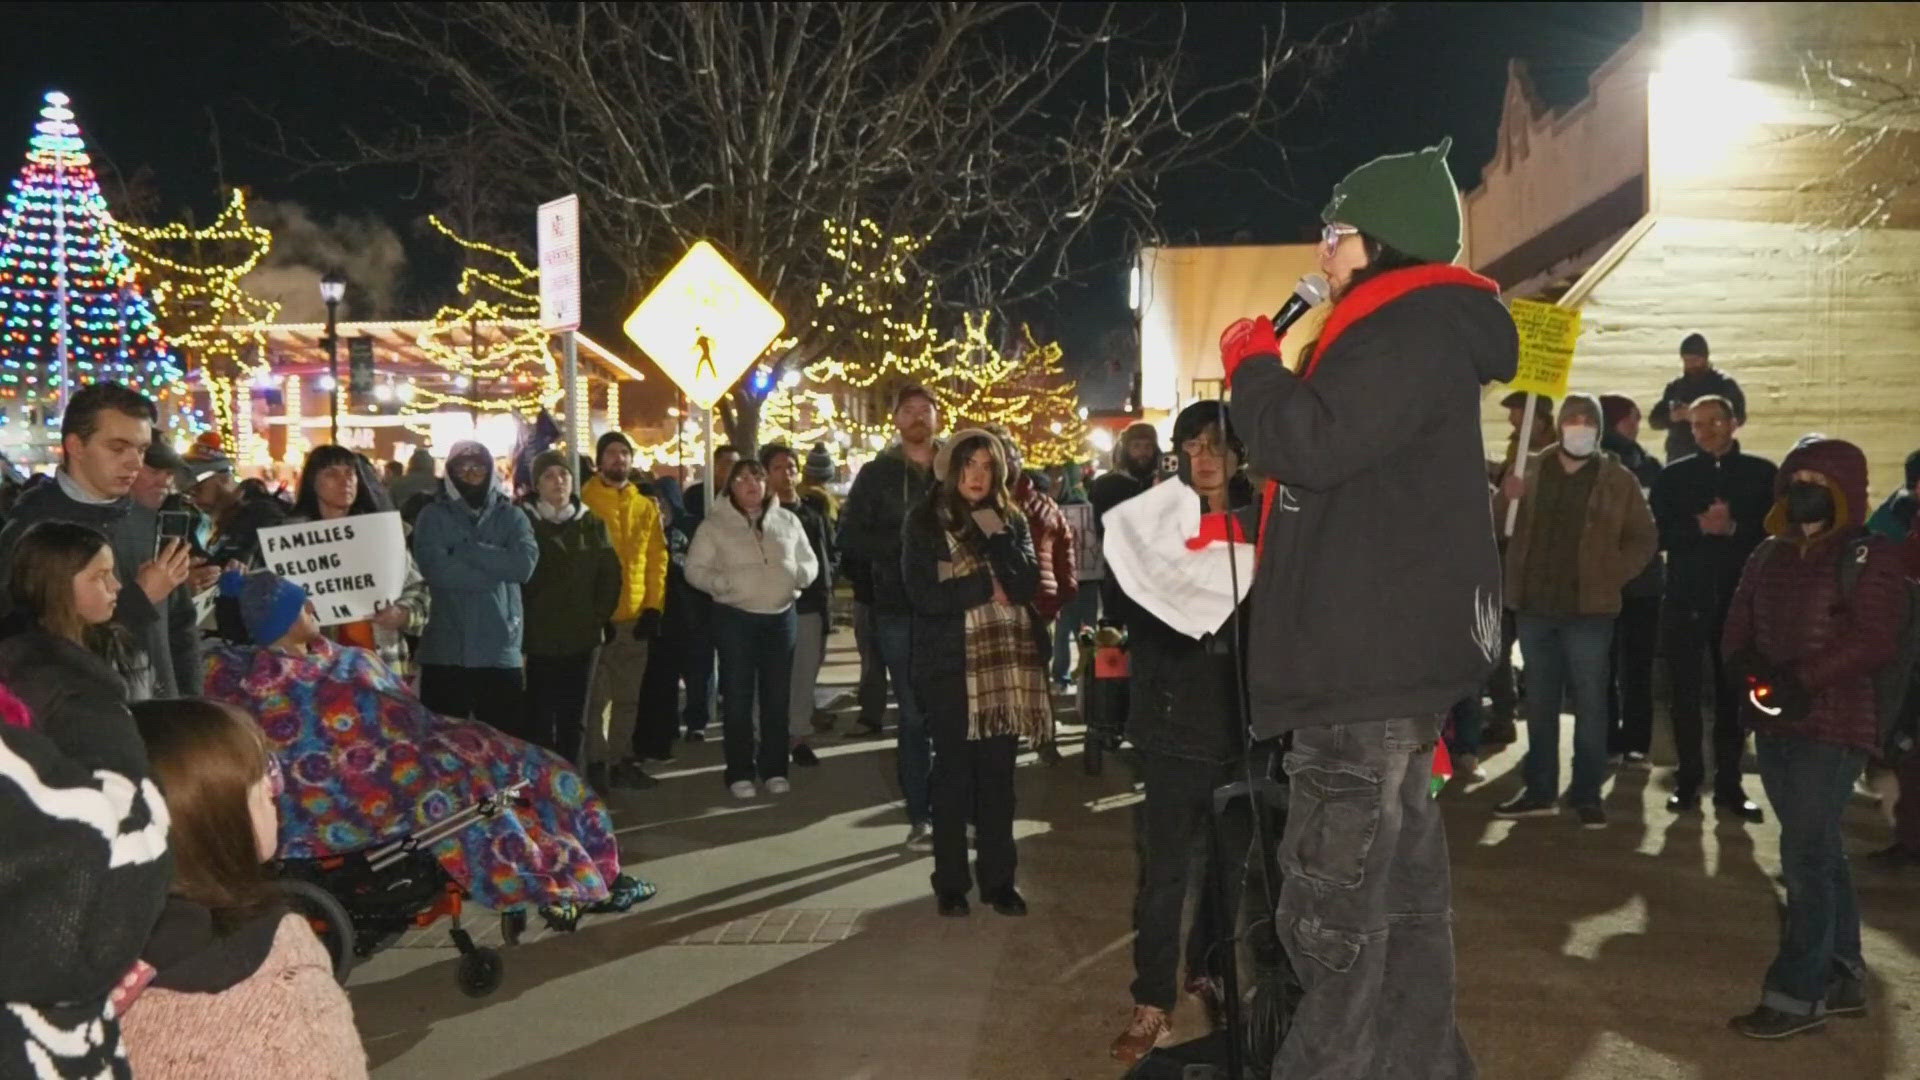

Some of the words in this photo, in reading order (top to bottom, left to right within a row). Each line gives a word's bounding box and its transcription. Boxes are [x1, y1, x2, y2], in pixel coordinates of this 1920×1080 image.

[267, 525, 355, 553] FAMILIES
[274, 553, 341, 577] BELONG
[332, 604, 352, 618] IN
